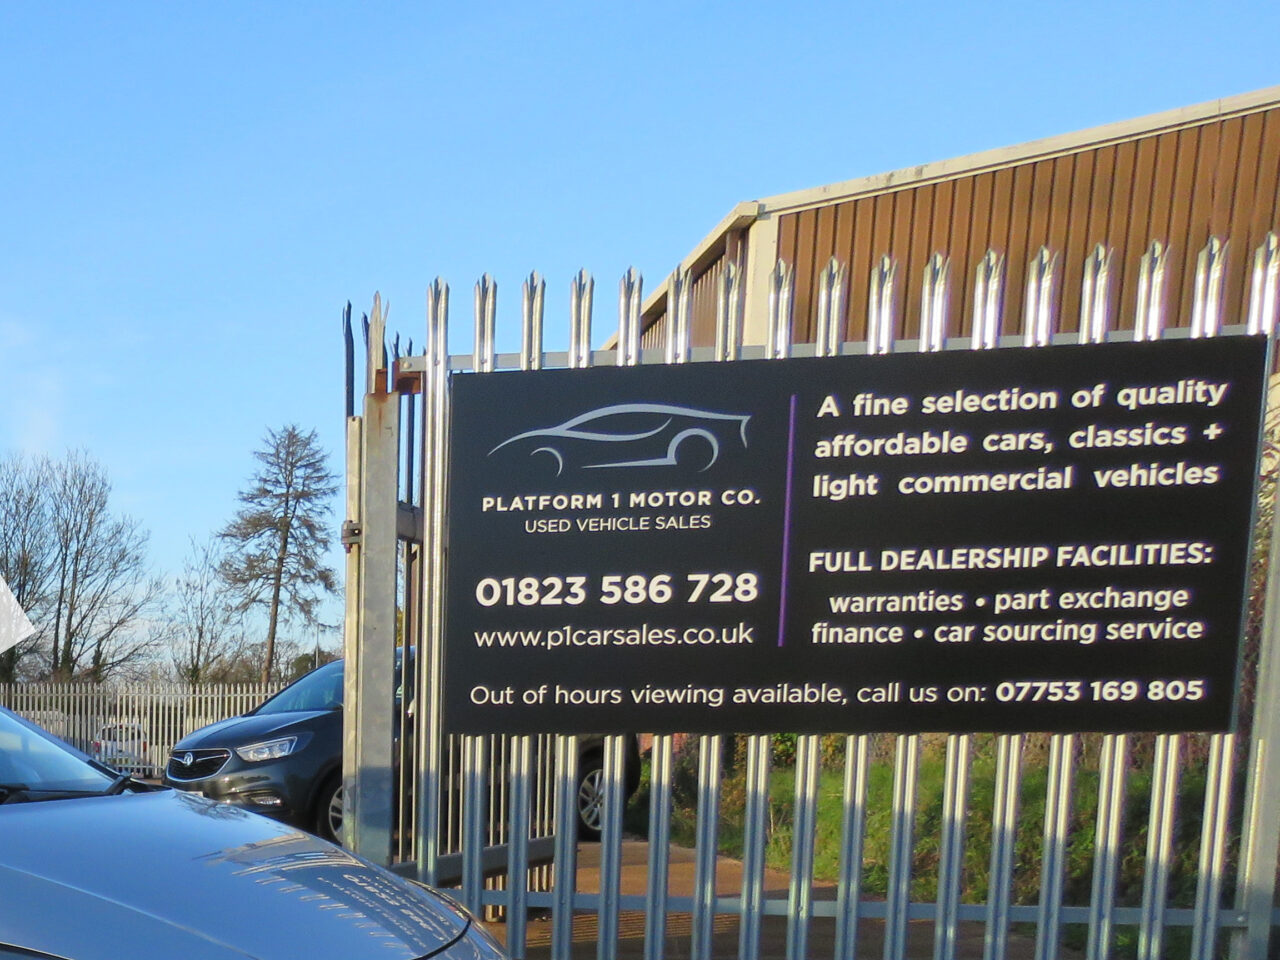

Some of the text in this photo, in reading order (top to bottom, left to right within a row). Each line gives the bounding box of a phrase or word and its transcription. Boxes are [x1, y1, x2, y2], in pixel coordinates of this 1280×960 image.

[817, 380, 1228, 417] A fine selection of quality
[815, 422, 1223, 457] affordable cars, classics +
[813, 462, 1219, 500] light commercial vehicles
[483, 490, 760, 511] PLATFORM 1 MOTOR CO.
[526, 515, 711, 533] USED VEHICLE SALES
[809, 543, 1213, 572] FULL DEALERSHIP FACILITIES:
[476, 573, 758, 606] 01823 586 728
[829, 587, 1189, 614] warranties part exchange
[474, 623, 753, 650] www.p1carsales.co.uk
[812, 618, 1205, 644] finance car sourcing service
[471, 680, 1203, 707] Out of hours viewing available, call us on: 07753 169 805
